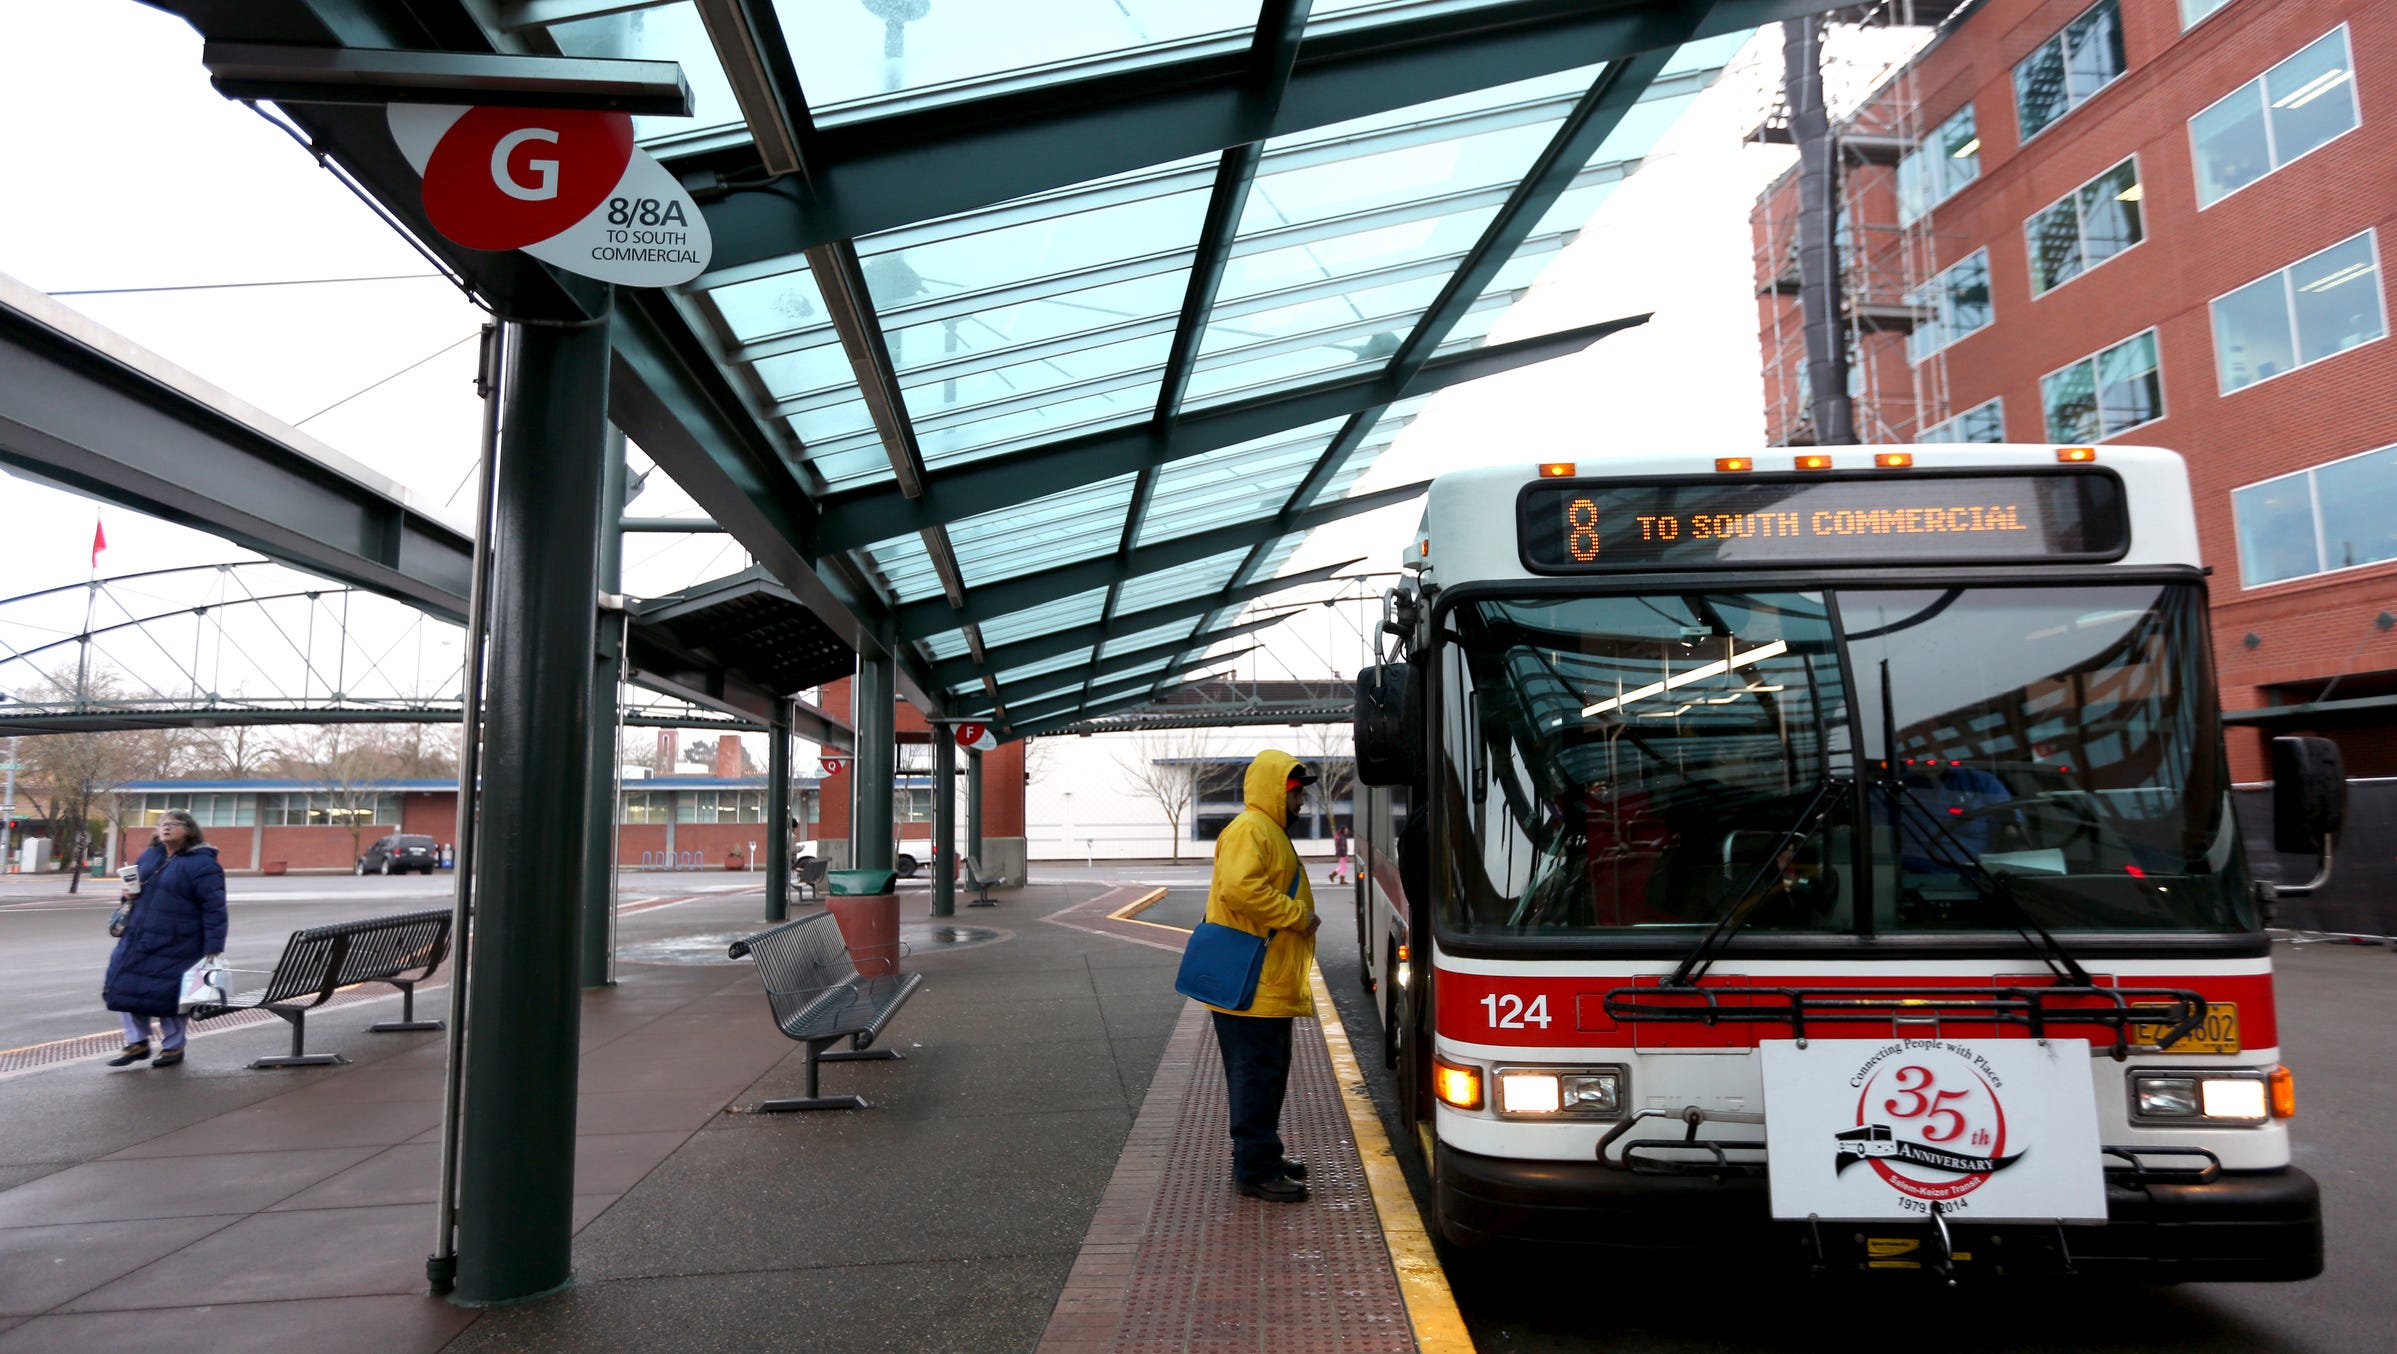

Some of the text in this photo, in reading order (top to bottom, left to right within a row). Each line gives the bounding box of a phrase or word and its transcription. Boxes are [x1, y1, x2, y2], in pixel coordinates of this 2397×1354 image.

[490, 127, 560, 201] G
[607, 197, 688, 228] 8/8A
[606, 230, 686, 245] TO SOUTH
[591, 247, 701, 263] COMMERCIAL
[1568, 498, 2028, 561] 8 TO SOUTH COMMERCIAL
[966, 726, 975, 739] F
[828, 761, 837, 772] Q
[1480, 993, 1552, 1029] 124
[1850, 1038, 2003, 1088] Connecting People with Places
[1898, 1143, 1994, 1171] ANNIVERSARY
[1889, 1175, 1982, 1196] Salem-Keizer Transit
[1898, 1196, 1968, 1213] 1979 2014
